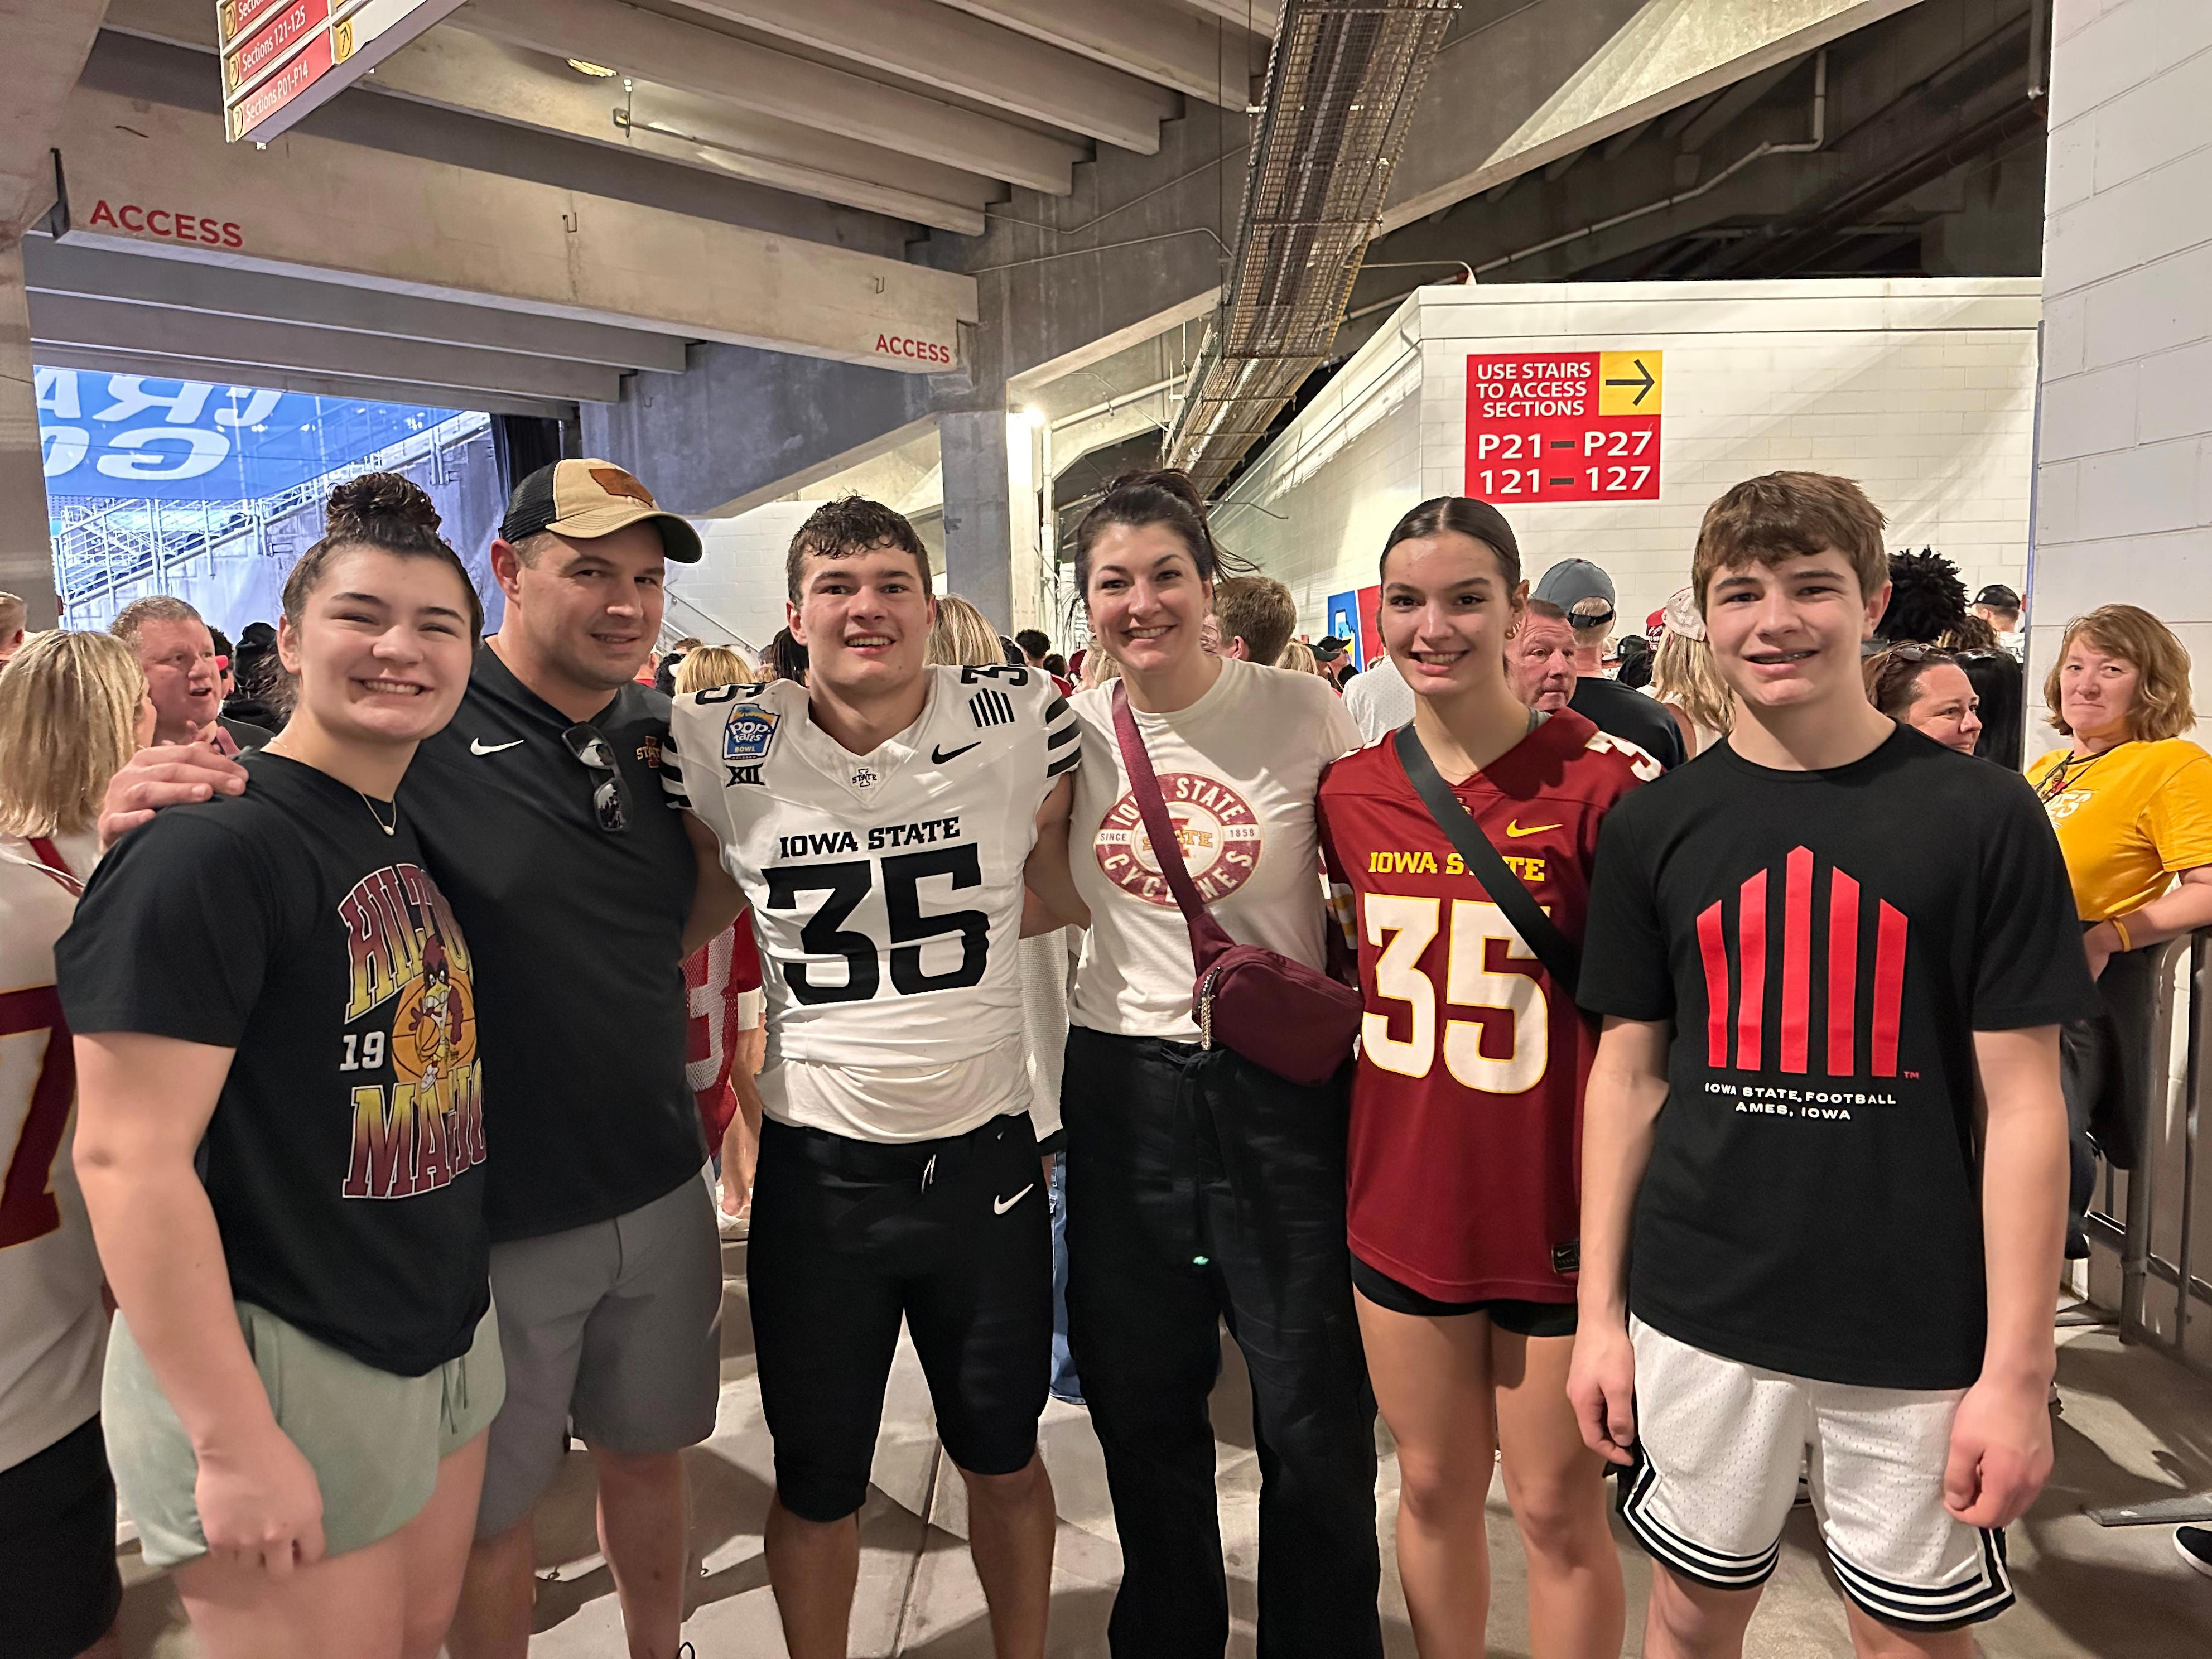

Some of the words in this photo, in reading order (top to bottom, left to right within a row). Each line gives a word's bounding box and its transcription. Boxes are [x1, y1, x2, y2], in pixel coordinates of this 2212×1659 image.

[242, 36, 273, 72] Sections
[274, 4, 306, 46] 121-125
[245, 89, 277, 123] Sections
[277, 60, 309, 99] P01-P14
[90, 200, 243, 248] ACCESS
[875, 334, 950, 364] ACCESS
[1478, 364, 1517, 380] USE
[1522, 362, 1591, 379] STAIRS
[1476, 383, 1505, 399] TO
[1509, 381, 1587, 398] ACCESS
[1483, 400, 1584, 418] SECTIONS
[1478, 433, 1541, 460] P21
[1584, 431, 1653, 457] P27
[1480, 469, 1540, 494] 121
[1585, 466, 1651, 491] 127
[636, 746, 661, 762] STAT
[726, 763, 766, 788] XII
[852, 774, 877, 784] STATE
[1175, 777, 1246, 823] STATE
[779, 831, 858, 859] IOWA
[868, 816, 961, 851] STATE
[1100, 833, 1127, 841] SINCE
[1230, 828, 1255, 837] 1858
[1142, 828, 1213, 851] SATE
[1103, 850, 1253, 903] CYCLNES
[1368, 851, 1438, 875] IOWA
[1445, 852, 1546, 882] STE
[760, 842, 990, 1006] 35
[338, 863, 473, 1025] HILTO
[1361, 892, 1551, 1094] 35
[339, 1031, 385, 1071] 19
[1705, 1082, 1737, 1096] IOWA
[1806, 1092, 1896, 1105] FOOTBALL
[1736, 1102, 1794, 1117] AMES,
[1801, 1107, 1851, 1120] IOWA
